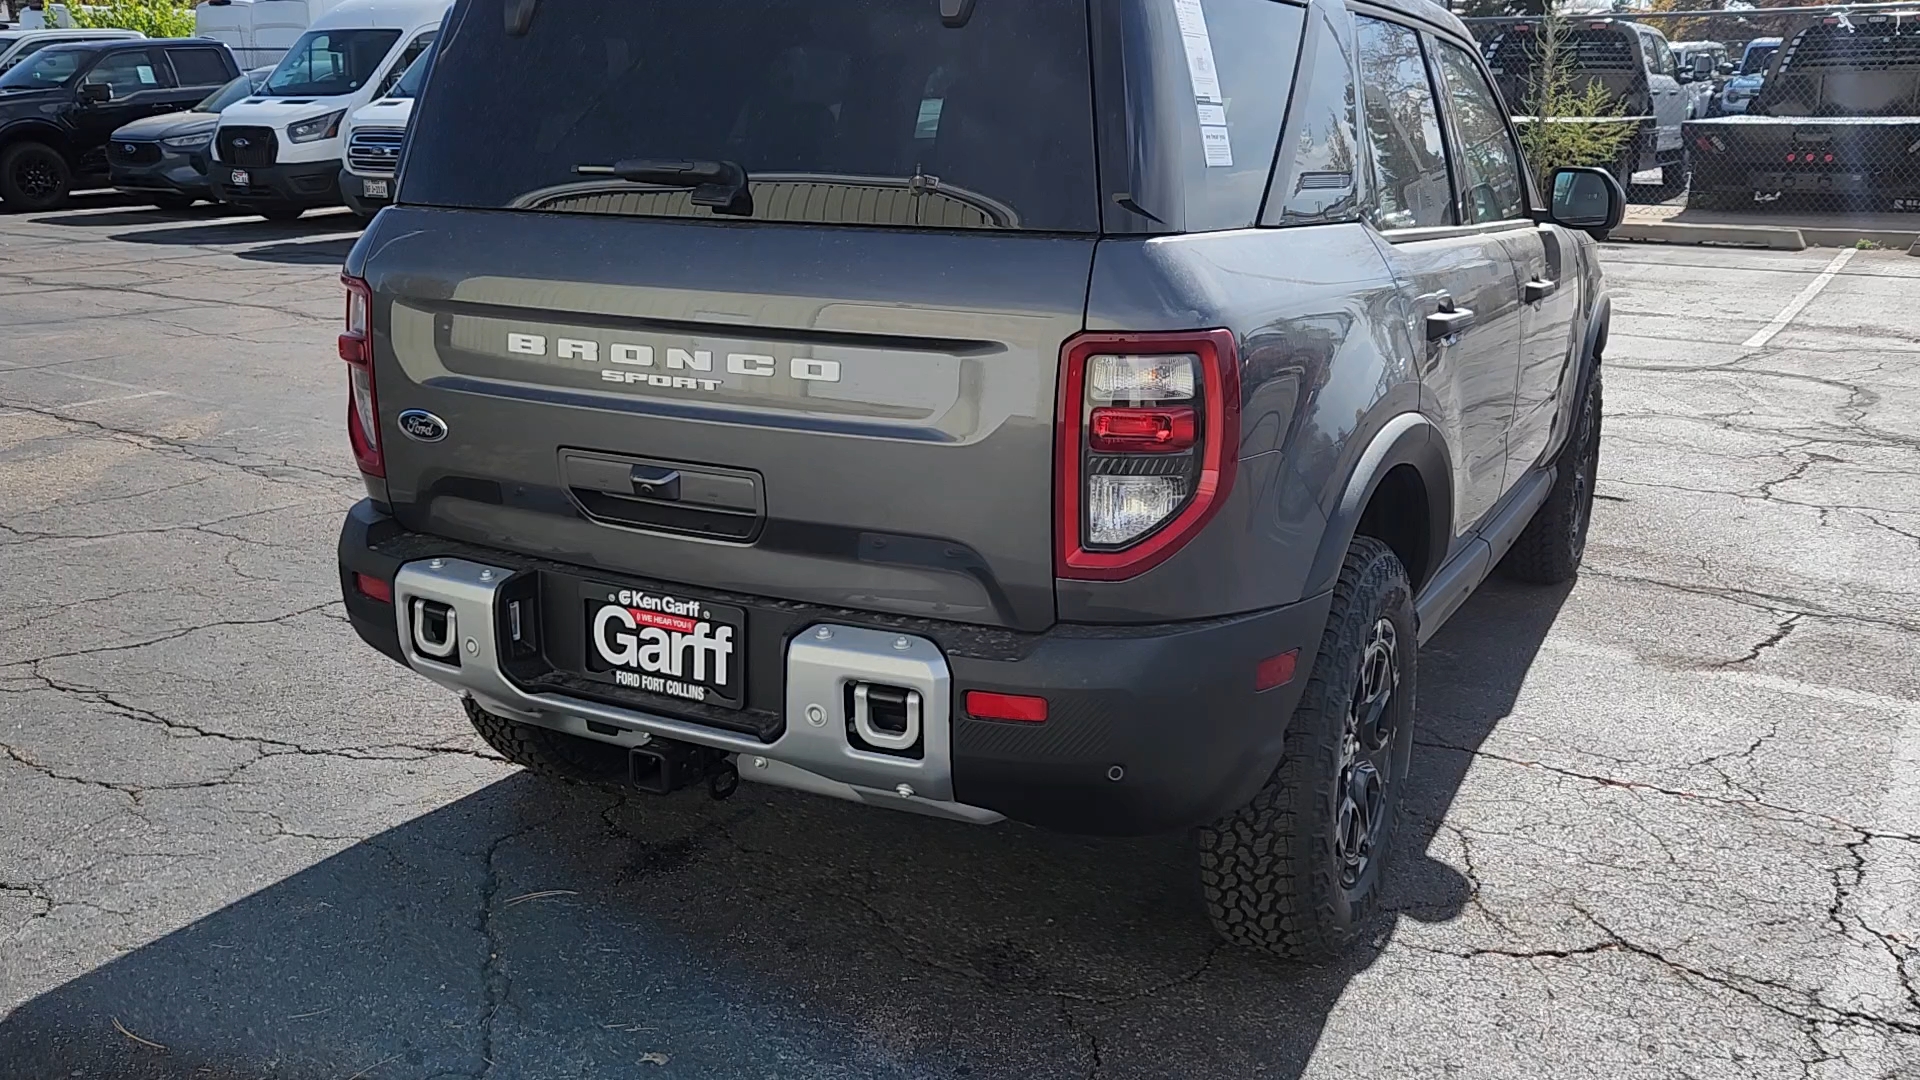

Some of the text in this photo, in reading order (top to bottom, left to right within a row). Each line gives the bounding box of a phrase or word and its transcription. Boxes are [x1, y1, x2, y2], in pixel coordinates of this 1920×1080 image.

[507, 332, 842, 383] BRONCO
[601, 369, 723, 391] SPORT
[407, 416, 434, 436] Ford
[641, 613, 687, 629] WE HEAR YOU
[593, 604, 733, 686] Garff
[615, 670, 705, 701] FORD FORT COLLINS
